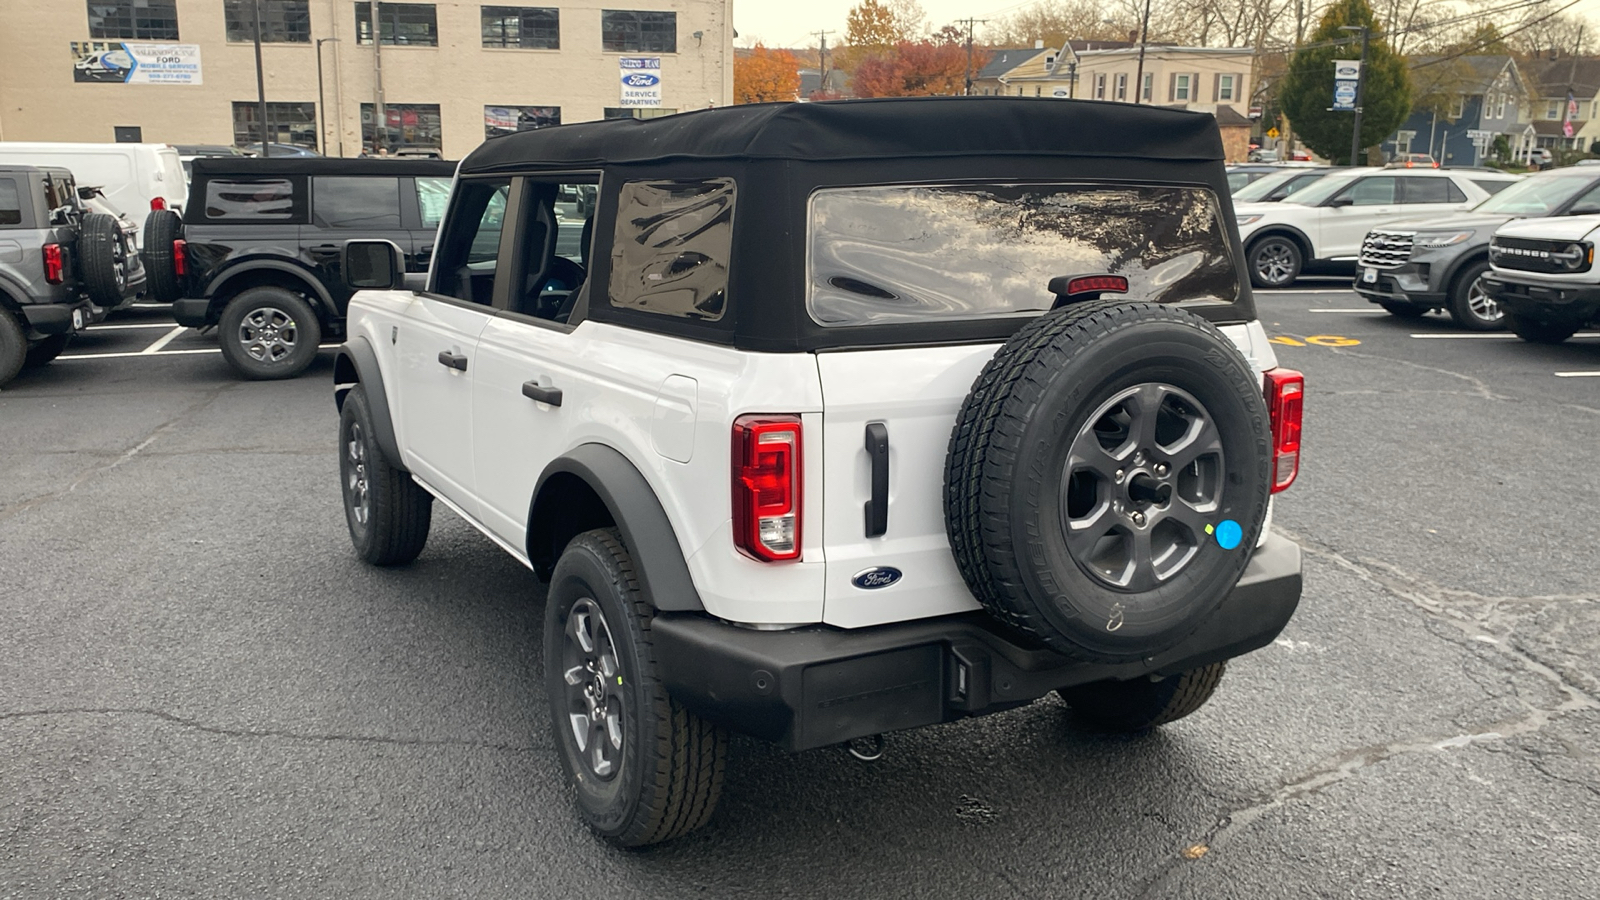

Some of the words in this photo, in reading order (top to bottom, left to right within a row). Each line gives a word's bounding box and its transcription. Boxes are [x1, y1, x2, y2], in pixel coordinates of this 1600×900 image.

[628, 74, 654, 86] Ford
[1500, 247, 1549, 258] BRONCO
[864, 571, 892, 586] Ford
